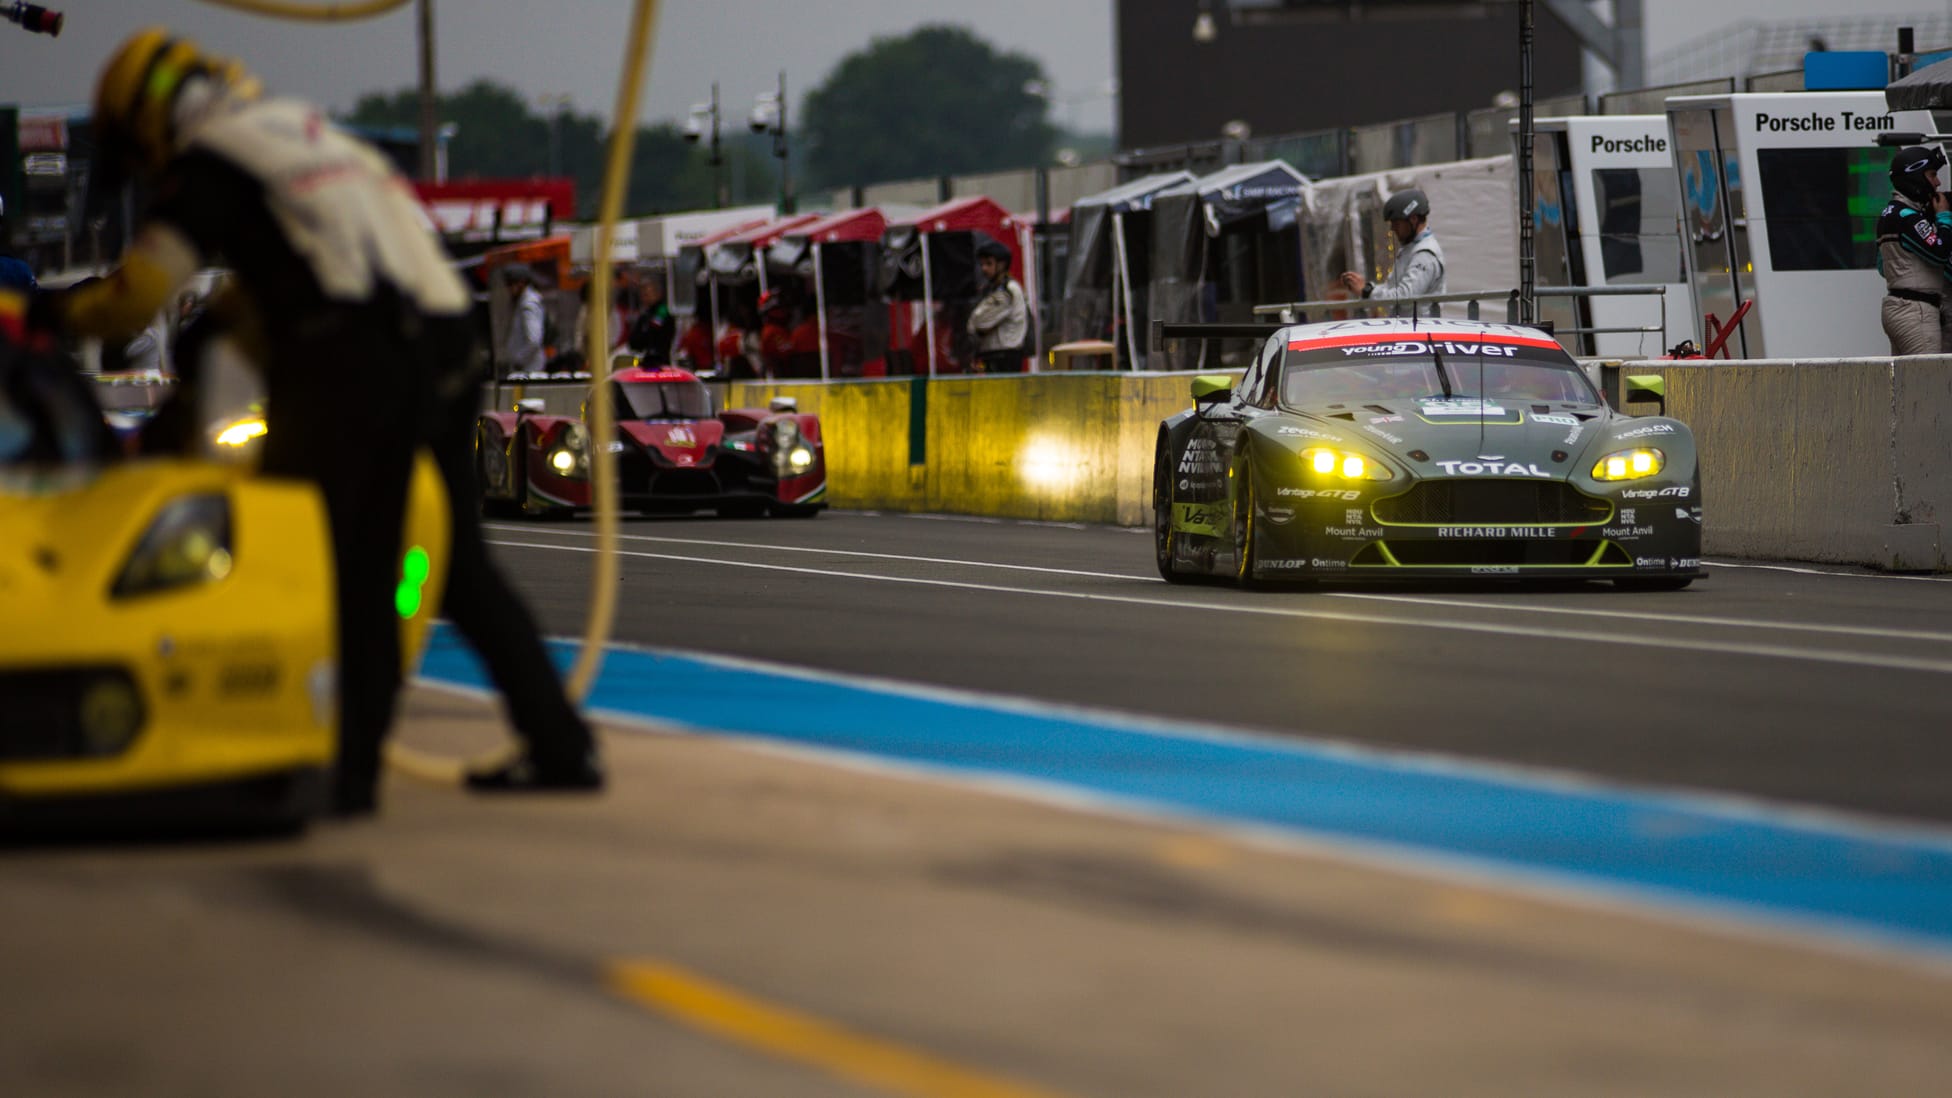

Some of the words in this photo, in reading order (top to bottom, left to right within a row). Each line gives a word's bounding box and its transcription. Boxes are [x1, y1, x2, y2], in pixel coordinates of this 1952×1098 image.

[1755, 112, 1835, 132] Porsche
[1841, 111, 1895, 131] Team
[1591, 134, 1666, 153] Porsche
[1342, 344, 1407, 356] young
[1392, 341, 1518, 356] Driver
[1277, 487, 1316, 499] Vantage
[1316, 489, 1361, 500] GT8
[1621, 488, 1659, 499] Vantage
[1658, 487, 1690, 497] GT8
[1325, 527, 1355, 537] Mount
[1358, 527, 1384, 536] Anvil
[1437, 527, 1506, 538] RICHARD
[1510, 527, 1556, 538] MILLE
[1602, 527, 1631, 537] Mount
[1632, 525, 1653, 535] Anvil
[1258, 559, 1306, 569] DUNLOP
[1312, 558, 1346, 568] Ontime
[1636, 557, 1665, 567] Ontime
